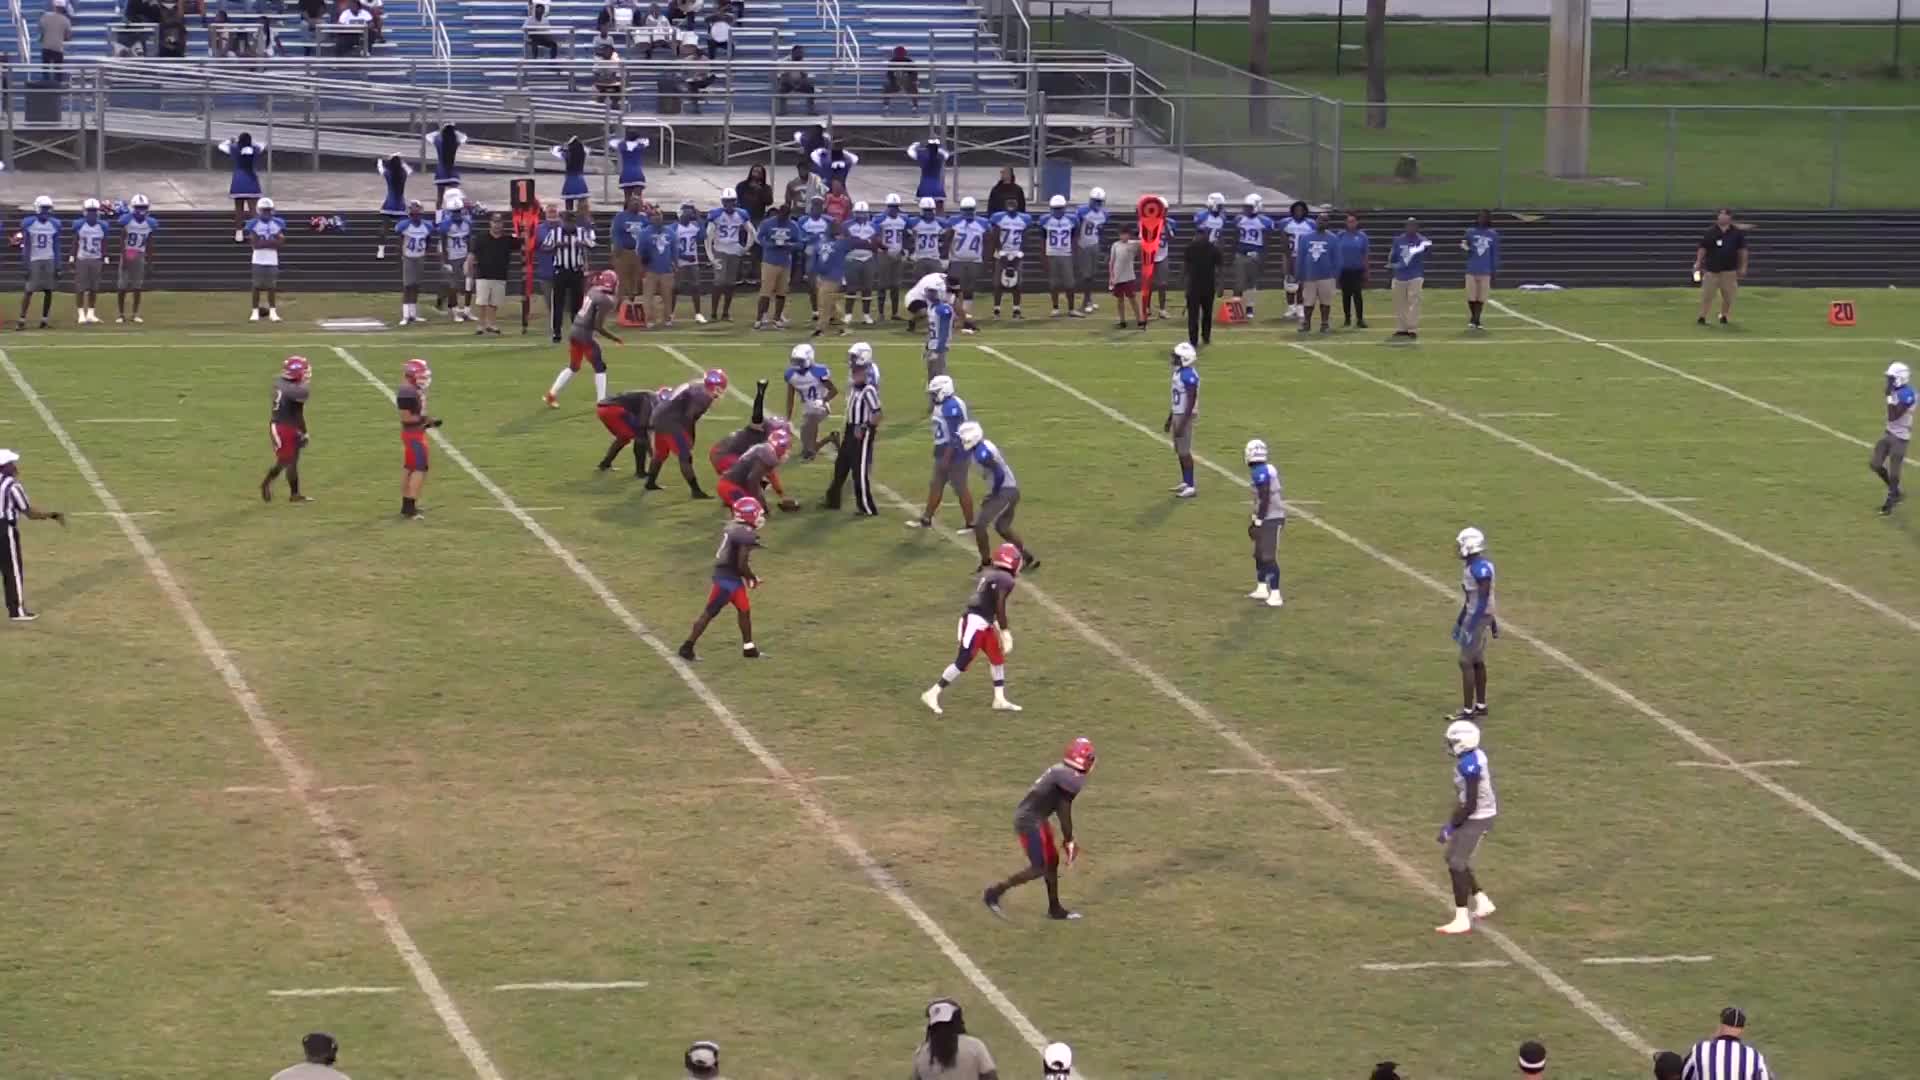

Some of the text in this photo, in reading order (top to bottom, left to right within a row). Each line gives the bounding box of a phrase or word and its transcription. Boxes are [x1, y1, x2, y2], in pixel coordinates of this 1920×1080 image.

[517, 181, 527, 203] 1
[36, 233, 47, 249] 9
[83, 236, 99, 254] 15
[957, 233, 980, 253] 74
[1001, 229, 1022, 246] 72
[1049, 230, 1070, 247] 62
[1225, 302, 1245, 321] 30
[1832, 303, 1854, 321] 20
